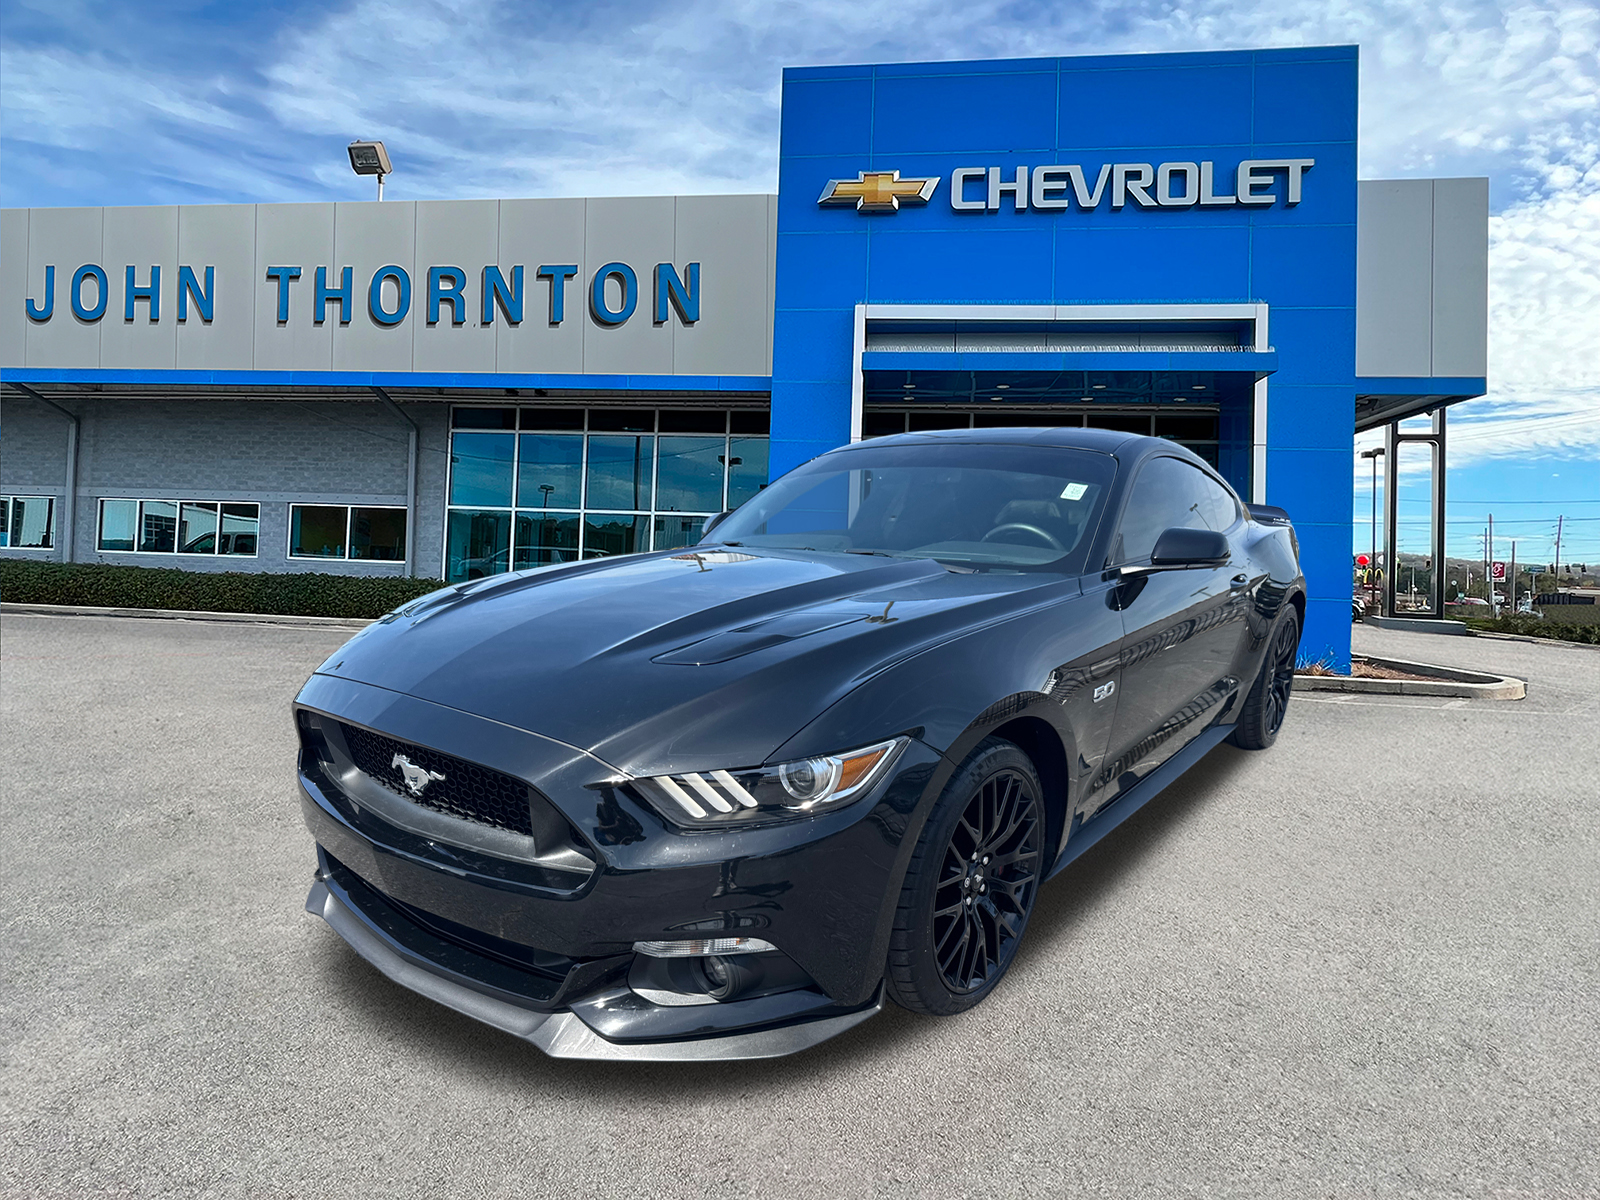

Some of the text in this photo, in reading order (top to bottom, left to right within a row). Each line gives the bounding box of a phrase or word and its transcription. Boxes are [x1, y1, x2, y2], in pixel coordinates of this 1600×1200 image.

[951, 158, 1315, 210] CHEVROLET
[25, 262, 702, 328] JOHN THORNTON
